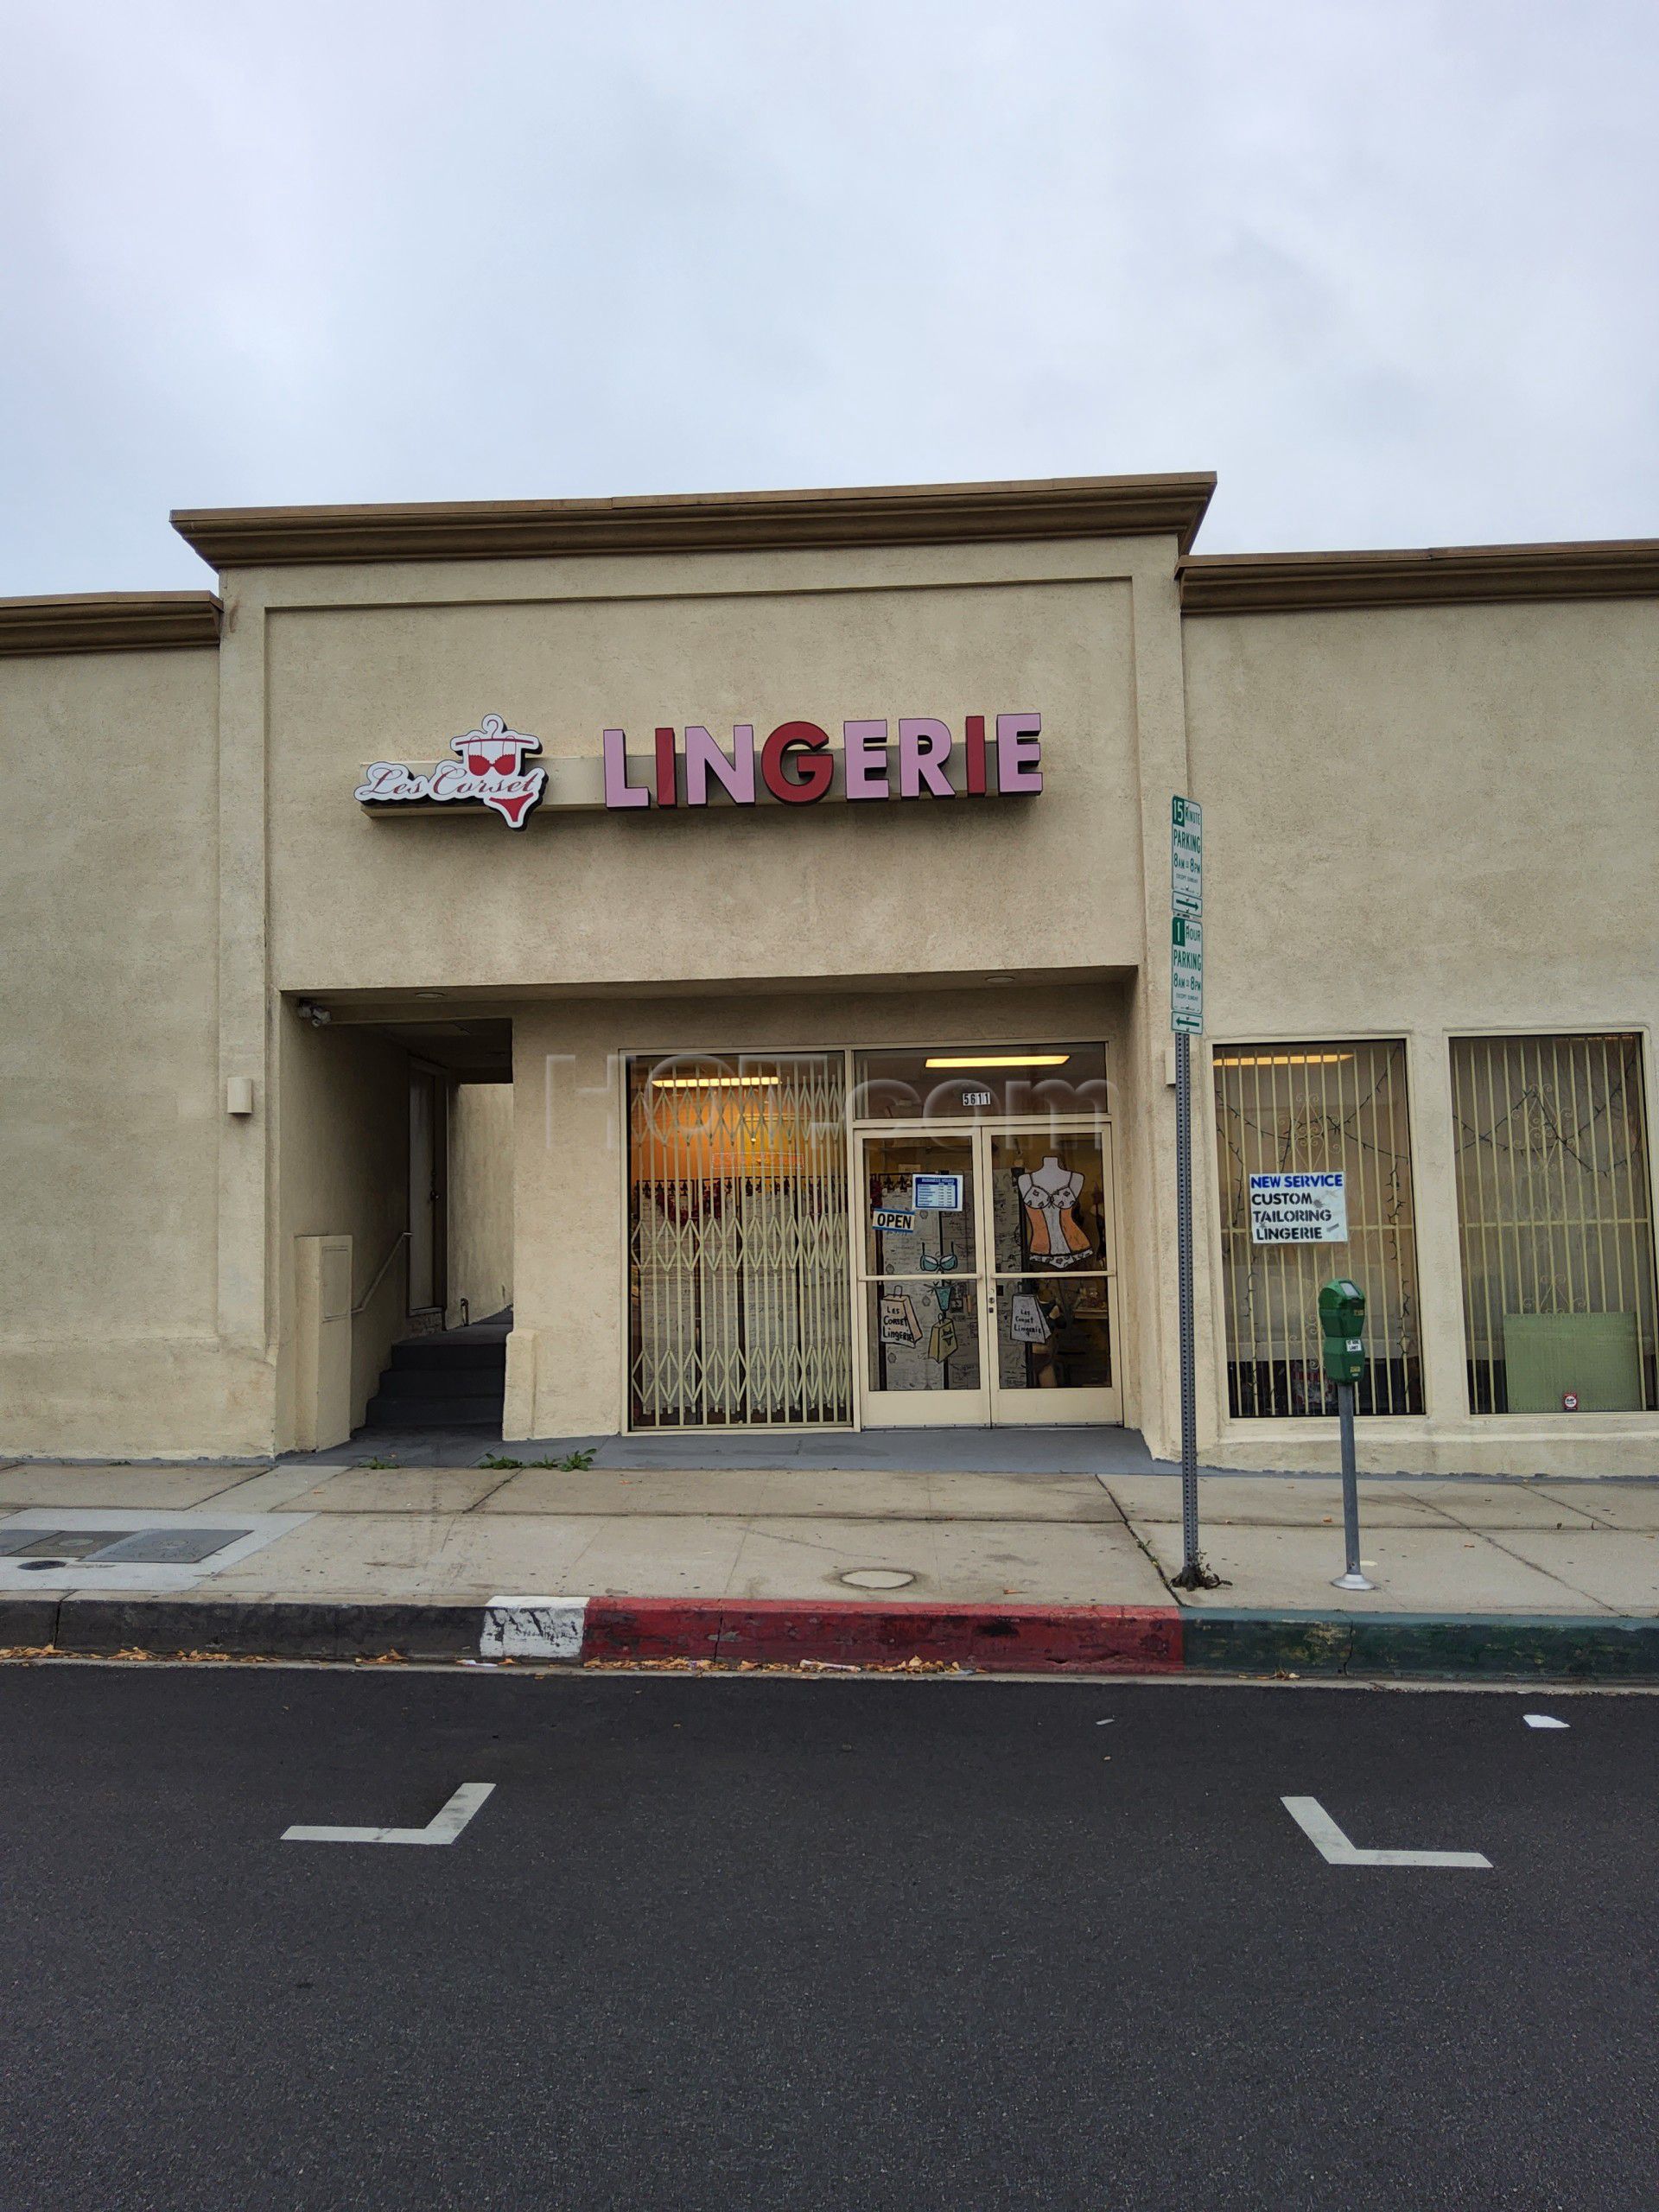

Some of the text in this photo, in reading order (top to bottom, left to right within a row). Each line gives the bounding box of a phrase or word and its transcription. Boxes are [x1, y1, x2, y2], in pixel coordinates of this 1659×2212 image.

[603, 713, 1043, 809] LINGERIE
[359, 766, 538, 796] Les Corset
[1173, 799, 1184, 823] 15
[1173, 828, 1201, 854] PARKING
[1185, 924, 1201, 942] HOUR
[1173, 949, 1201, 971] PARKING
[963, 1093, 988, 1105] 5611
[1250, 1174, 1343, 1188] NEW SERVICE
[1251, 1192, 1313, 1205] CUSTOM
[877, 1212, 912, 1230] OPEN
[1253, 1209, 1332, 1223] TAILORING
[1256, 1227, 1323, 1240] LINGERIE
